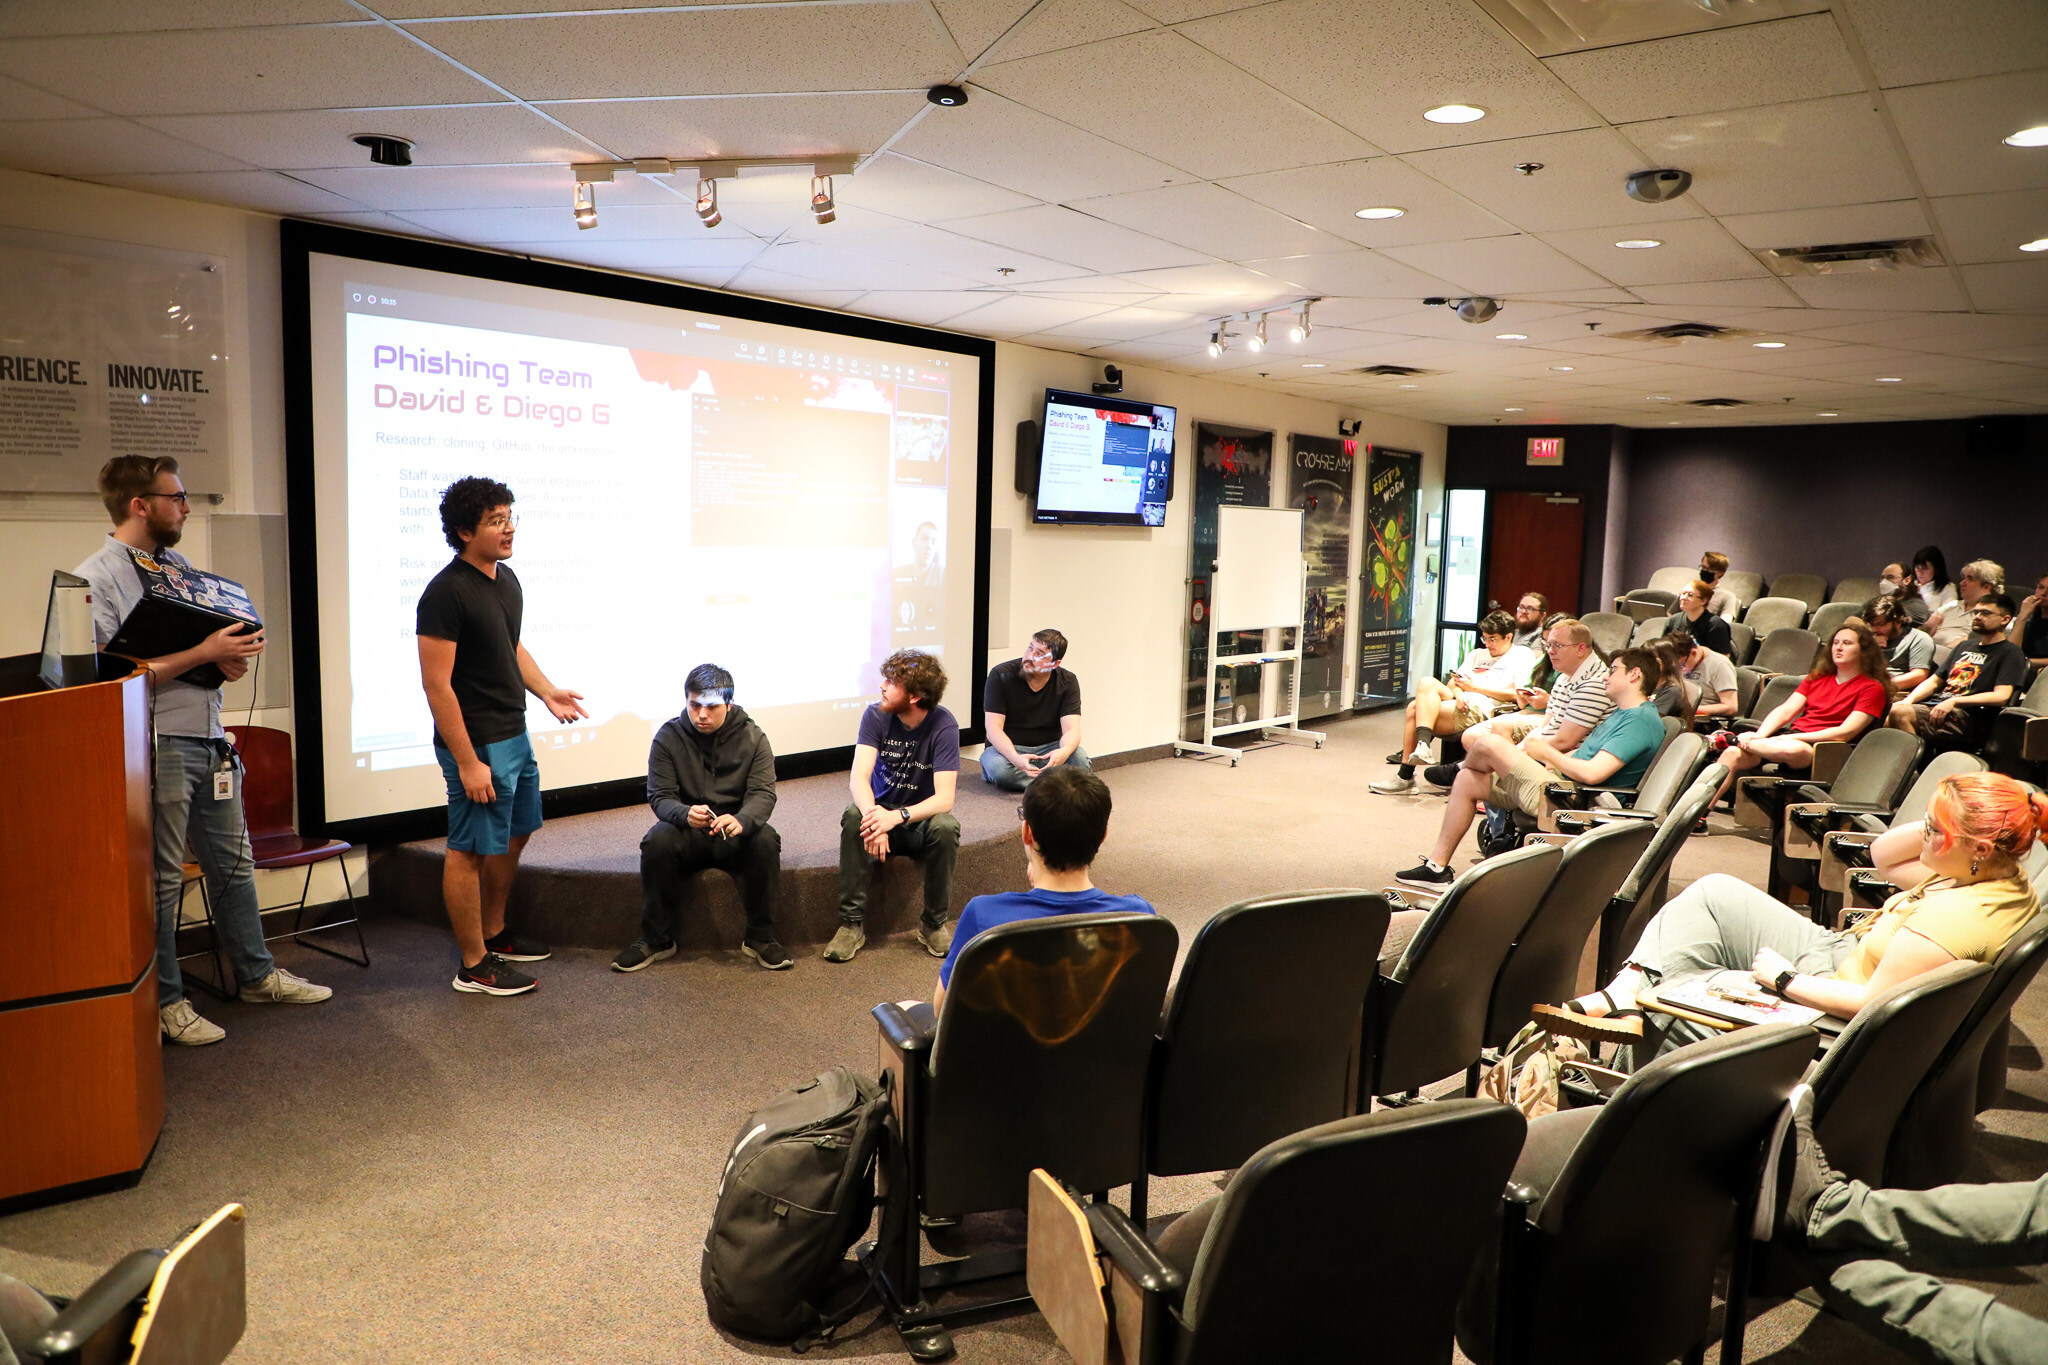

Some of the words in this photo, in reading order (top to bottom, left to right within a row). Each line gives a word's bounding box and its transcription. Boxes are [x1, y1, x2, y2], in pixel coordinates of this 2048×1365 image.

[374, 345, 509, 388] Phishing
[519, 360, 592, 389] Team
[108, 363, 209, 393] INNOVATE.
[374, 384, 465, 414] David
[476, 395, 493, 415] &
[504, 395, 582, 428] Diego
[592, 403, 610, 424] G
[1050, 410, 1073, 421] Phishing
[1049, 419, 1064, 429] David
[1533, 439, 1559, 458] EXIT
[399, 469, 428, 481] Staff
[432, 474, 455, 482] was
[399, 487, 428, 499] Data
[399, 506, 433, 517] starts
[399, 523, 424, 535] with
[399, 557, 427, 570] Risk
